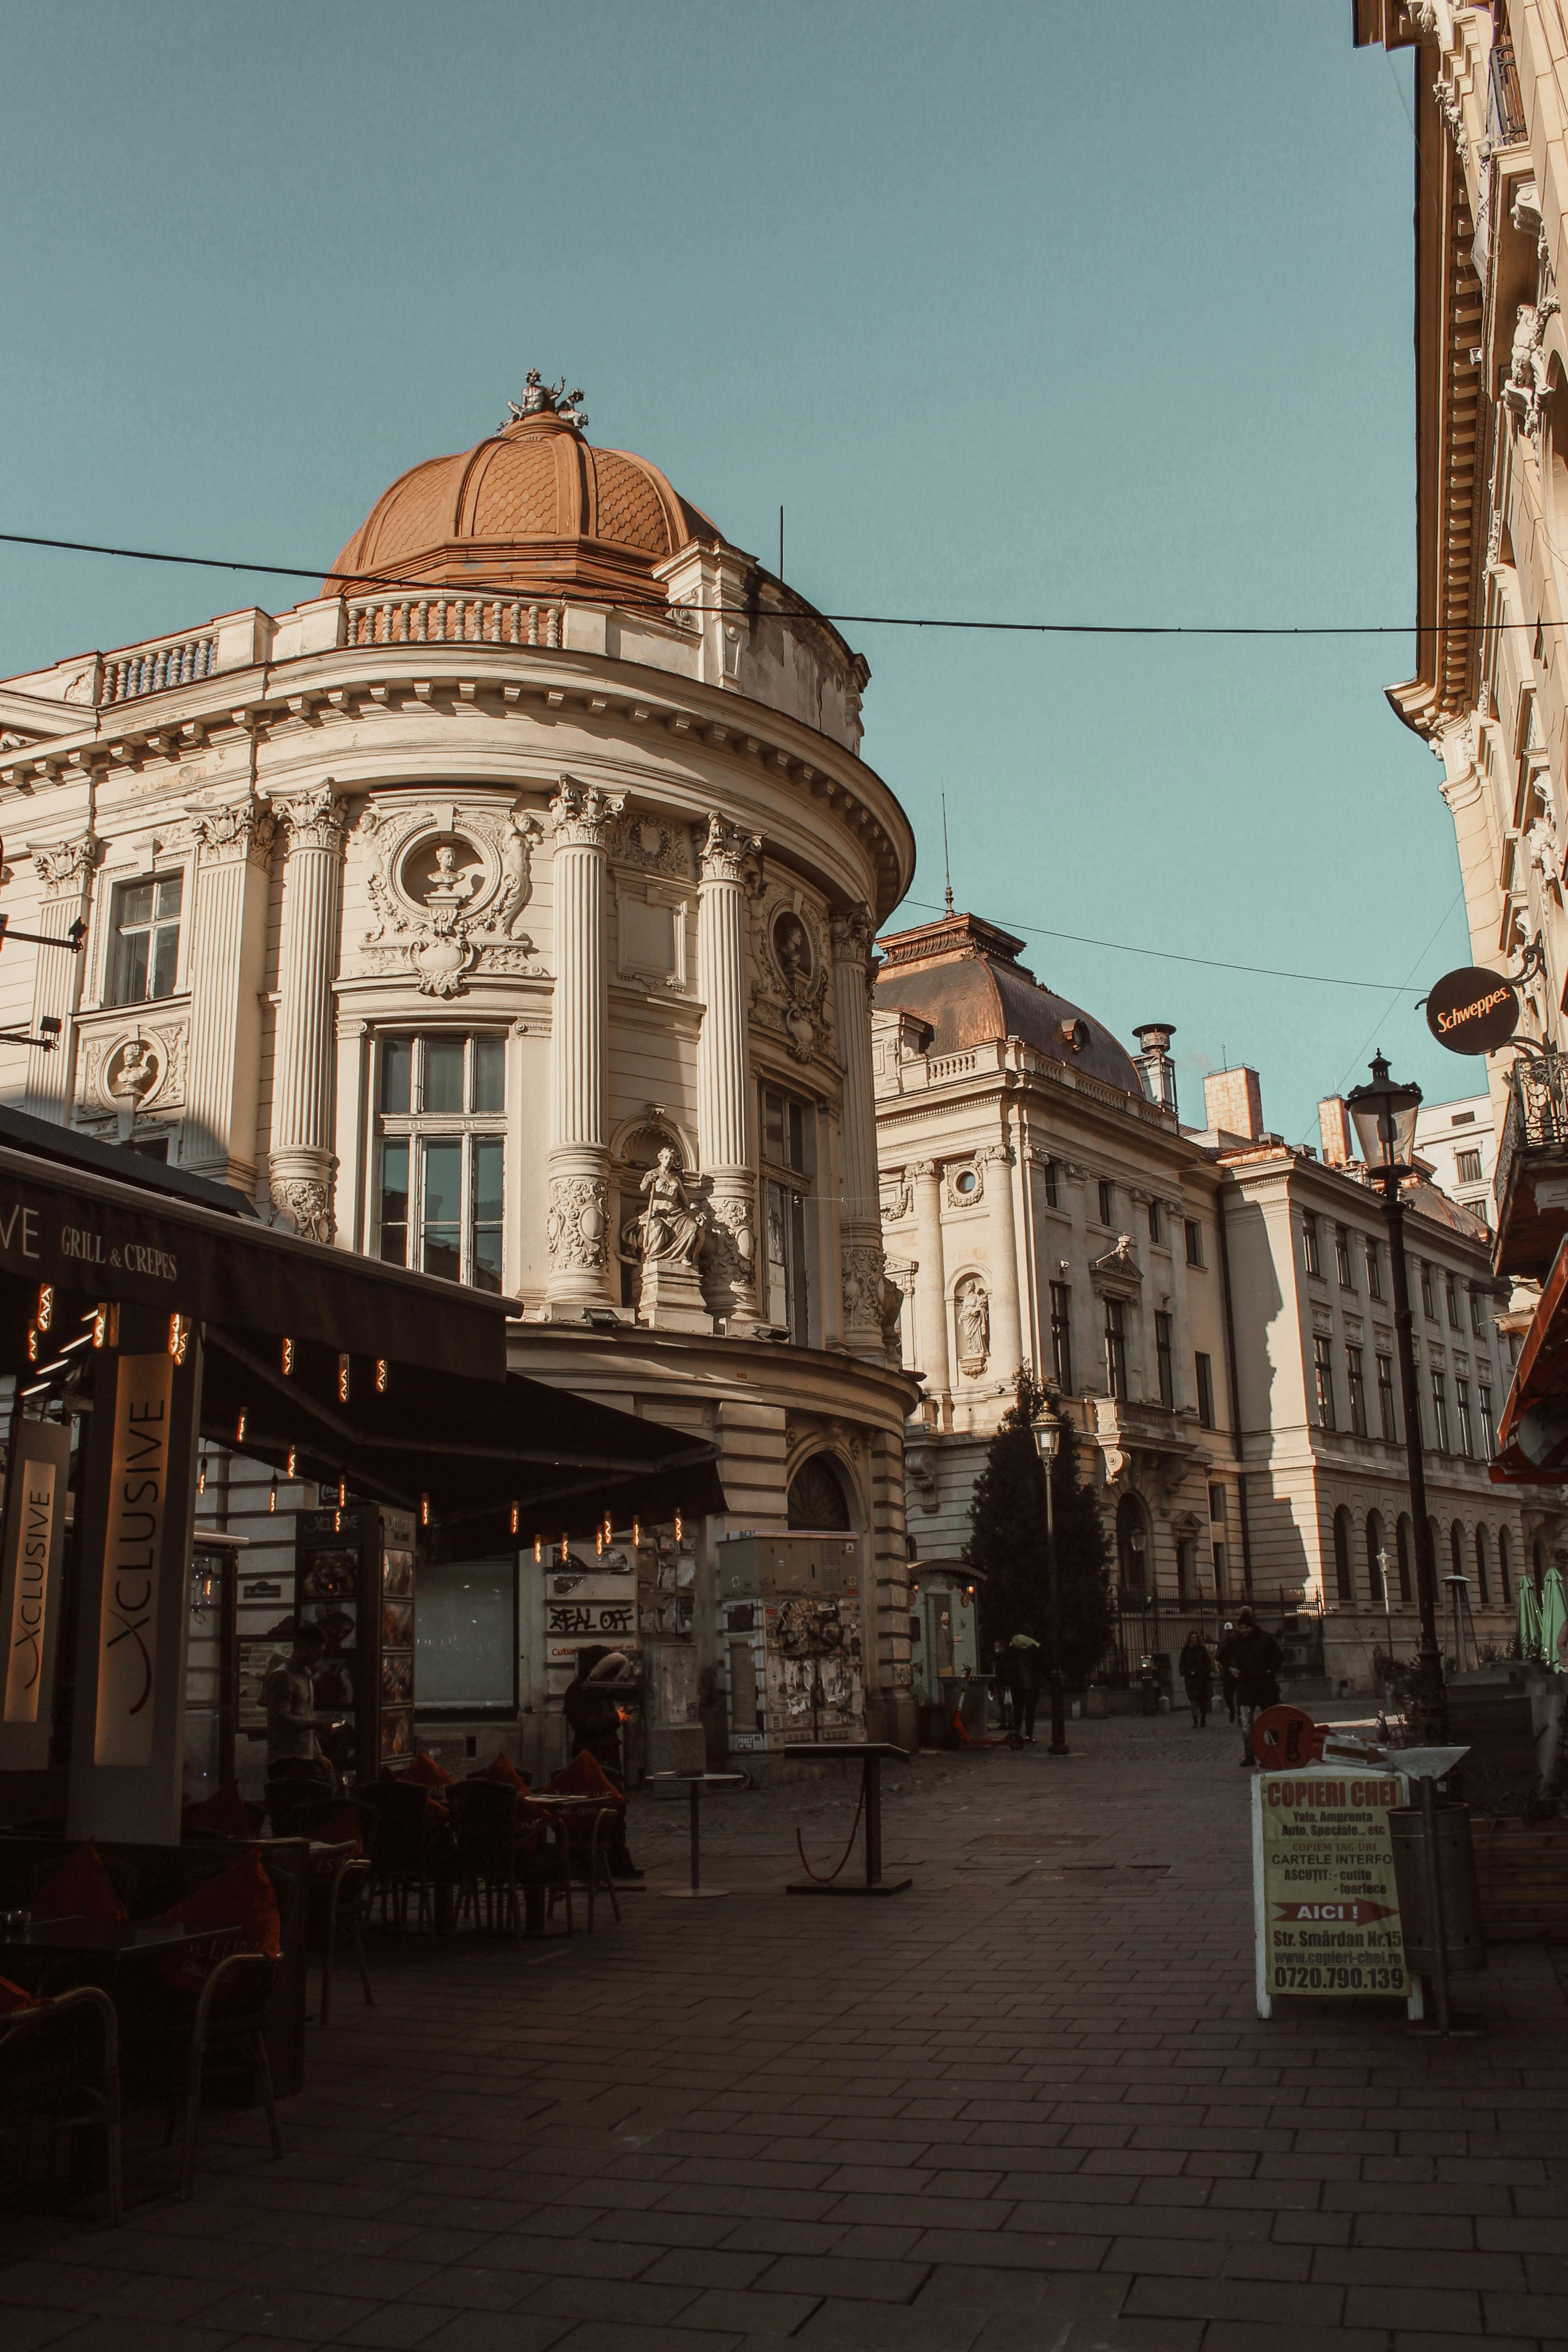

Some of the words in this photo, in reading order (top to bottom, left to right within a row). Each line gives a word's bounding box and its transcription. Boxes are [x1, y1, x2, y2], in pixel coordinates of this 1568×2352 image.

[62, 1226, 106, 1263] GRILL
[110, 1249, 122, 1267] &
[125, 1244, 177, 1281] CREPES
[107, 1400, 165, 1715] XCLUSIVE
[15, 1490, 50, 1690] XCLUSIVE
[1267, 1781, 1346, 1807] COPIERI
[1351, 1781, 1397, 1807] CHEI
[1293, 1811, 1318, 1823] Yala,
[1320, 1811, 1373, 1823] Amprenta
[1282, 1825, 1308, 1837] Auto,
[1311, 1824, 1366, 1837] Speciale...
[1368, 1825, 1385, 1835] etc
[1293, 1843, 1332, 1852] COPIEM
[1334, 1843, 1376, 1852] TAG-URI
[1272, 1854, 1332, 1865] CARTELE
[1340, 1869, 1372, 1880] cutite
[1340, 1883, 1387, 1895] foarfece
[1297, 1906, 1344, 1919] AICI
[1273, 1930, 1296, 1947] Str.
[1299, 1930, 1364, 1947] Smârdan
[1367, 1930, 1402, 1947] Nr.15
[1274, 1951, 1402, 1965] www.copieri-chei.ro
[1274, 1966, 1404, 1989] 0720.790.139
